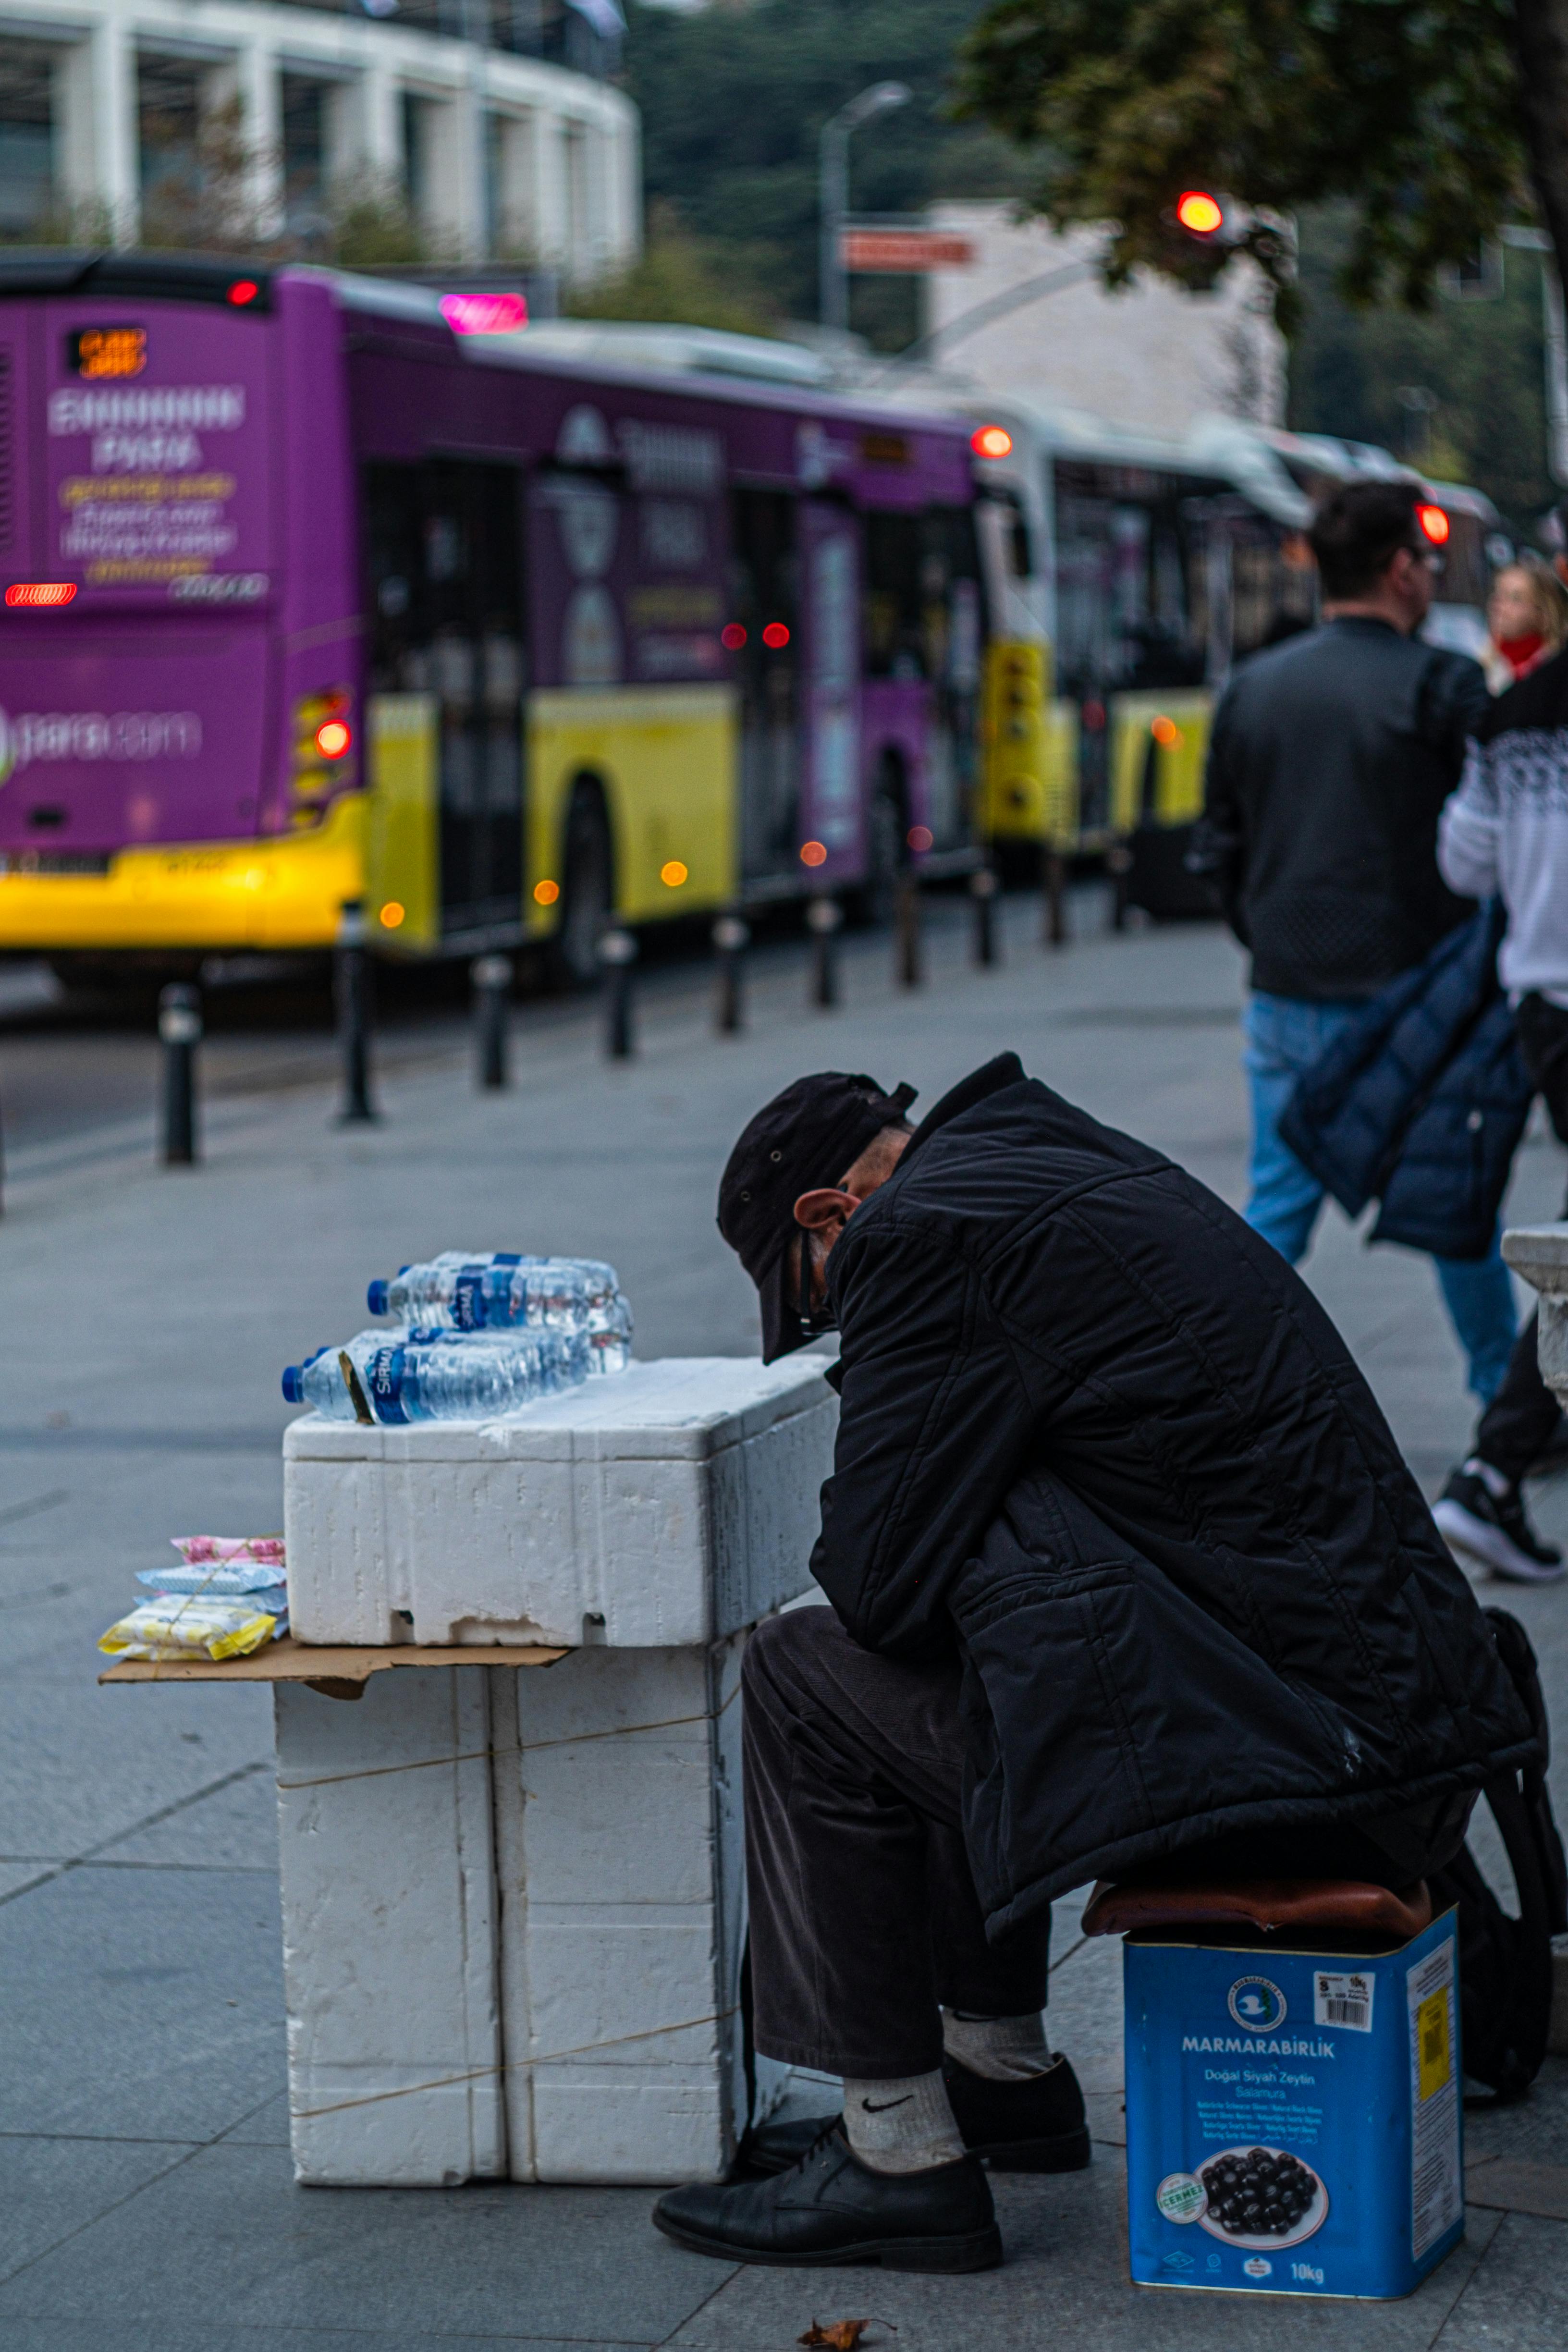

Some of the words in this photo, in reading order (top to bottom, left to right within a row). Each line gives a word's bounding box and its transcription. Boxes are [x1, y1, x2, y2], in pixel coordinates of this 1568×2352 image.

[1182, 2035, 1335, 2058] MARMARABİRLİK
[1205, 2069, 1239, 2083] Doğal
[1243, 2070, 1276, 2084] Siyah
[1279, 2072, 1315, 2087] Zeytin
[1291, 2262, 1324, 2284] 10kg
